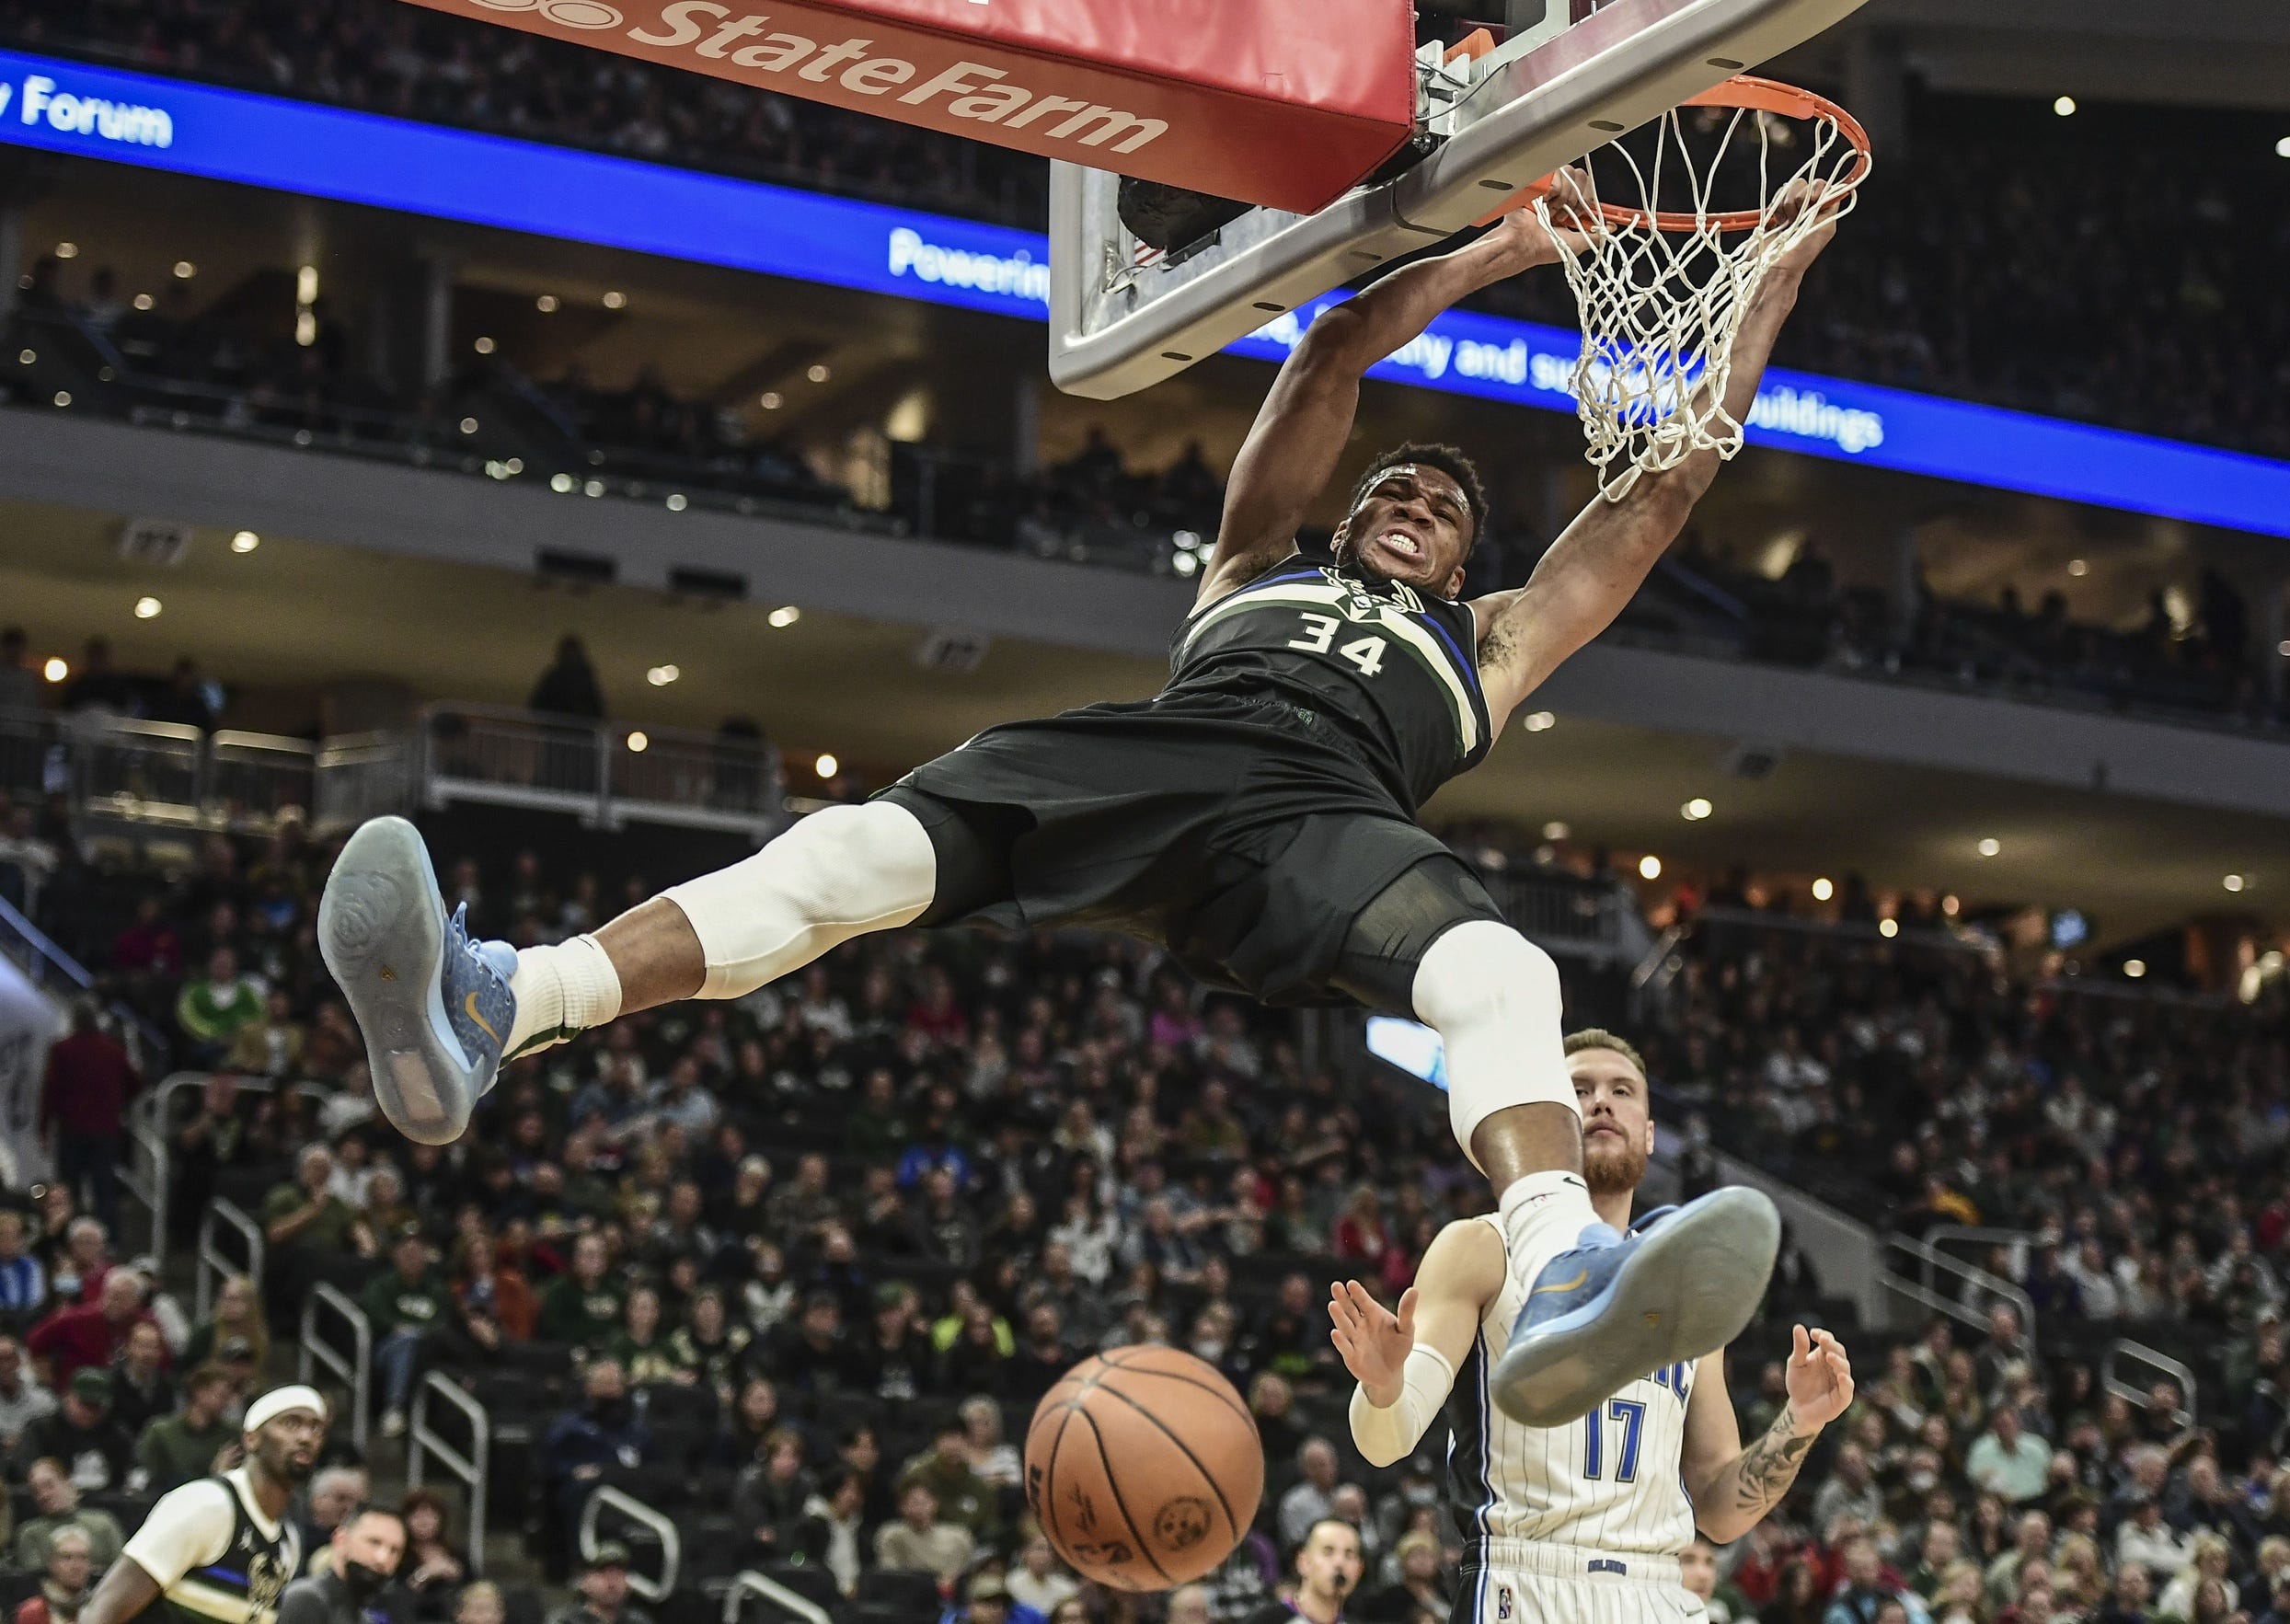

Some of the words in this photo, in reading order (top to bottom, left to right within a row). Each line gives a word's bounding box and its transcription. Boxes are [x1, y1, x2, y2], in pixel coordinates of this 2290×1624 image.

[21, 74, 173, 149] Forum
[889, 226, 1051, 309] Powerin
[1455, 337, 1528, 385] and
[1288, 611, 1388, 677] 34
[1583, 1398, 1647, 1483] 17
